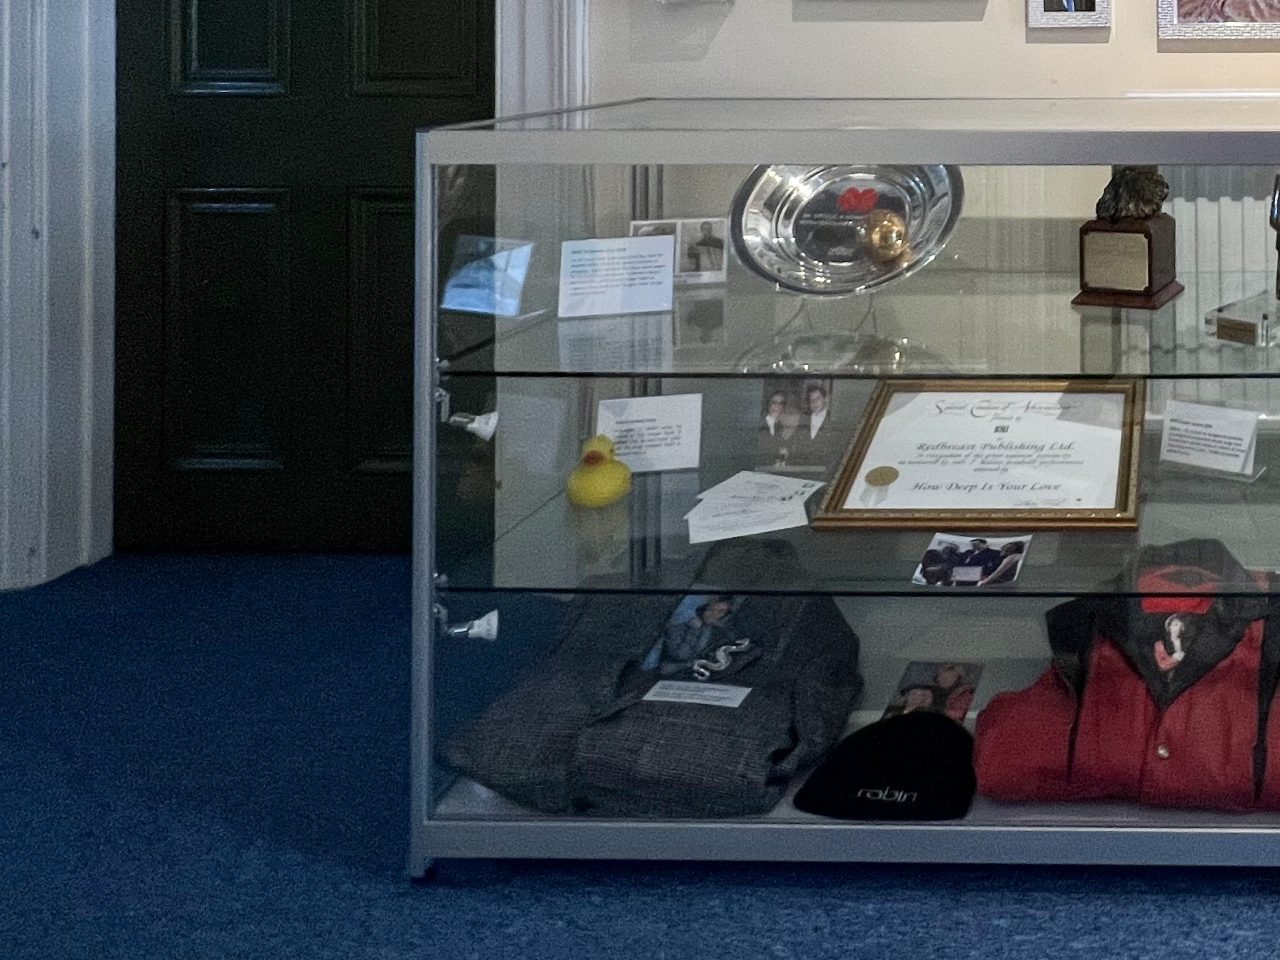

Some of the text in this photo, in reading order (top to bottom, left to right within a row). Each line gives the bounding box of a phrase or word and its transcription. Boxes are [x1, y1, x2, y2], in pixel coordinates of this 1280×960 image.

[980, 442, 1046, 452] Publishing
[913, 482, 1061, 493] How Deep Is Your Love
[857, 786, 918, 803] robin
